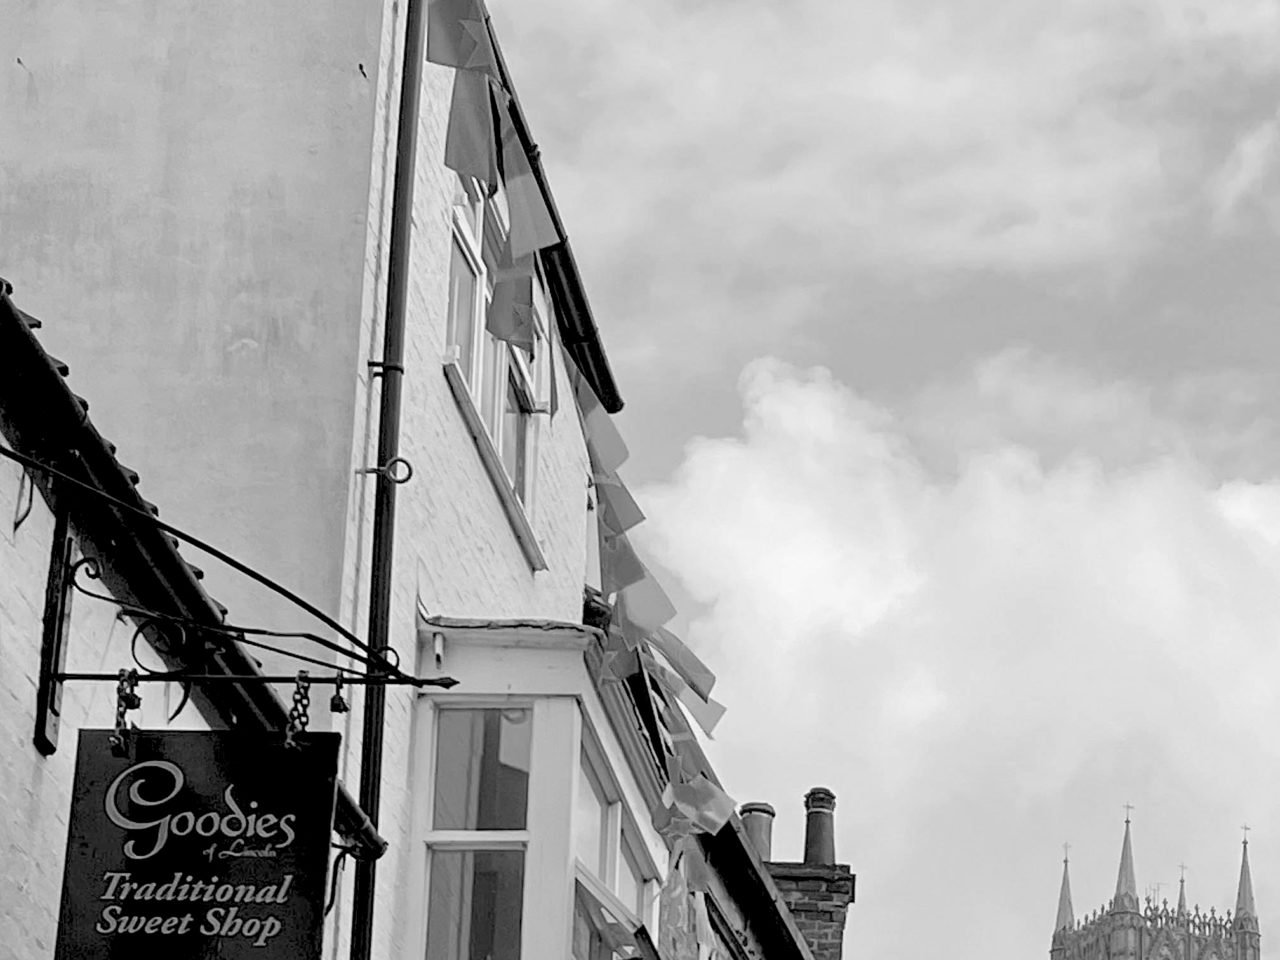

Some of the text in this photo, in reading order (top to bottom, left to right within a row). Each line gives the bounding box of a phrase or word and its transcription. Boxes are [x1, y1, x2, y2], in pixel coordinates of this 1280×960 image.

[105, 760, 296, 860] Goodies
[100, 872, 294, 904] Traditional
[96, 905, 282, 947] Sweet Shop
